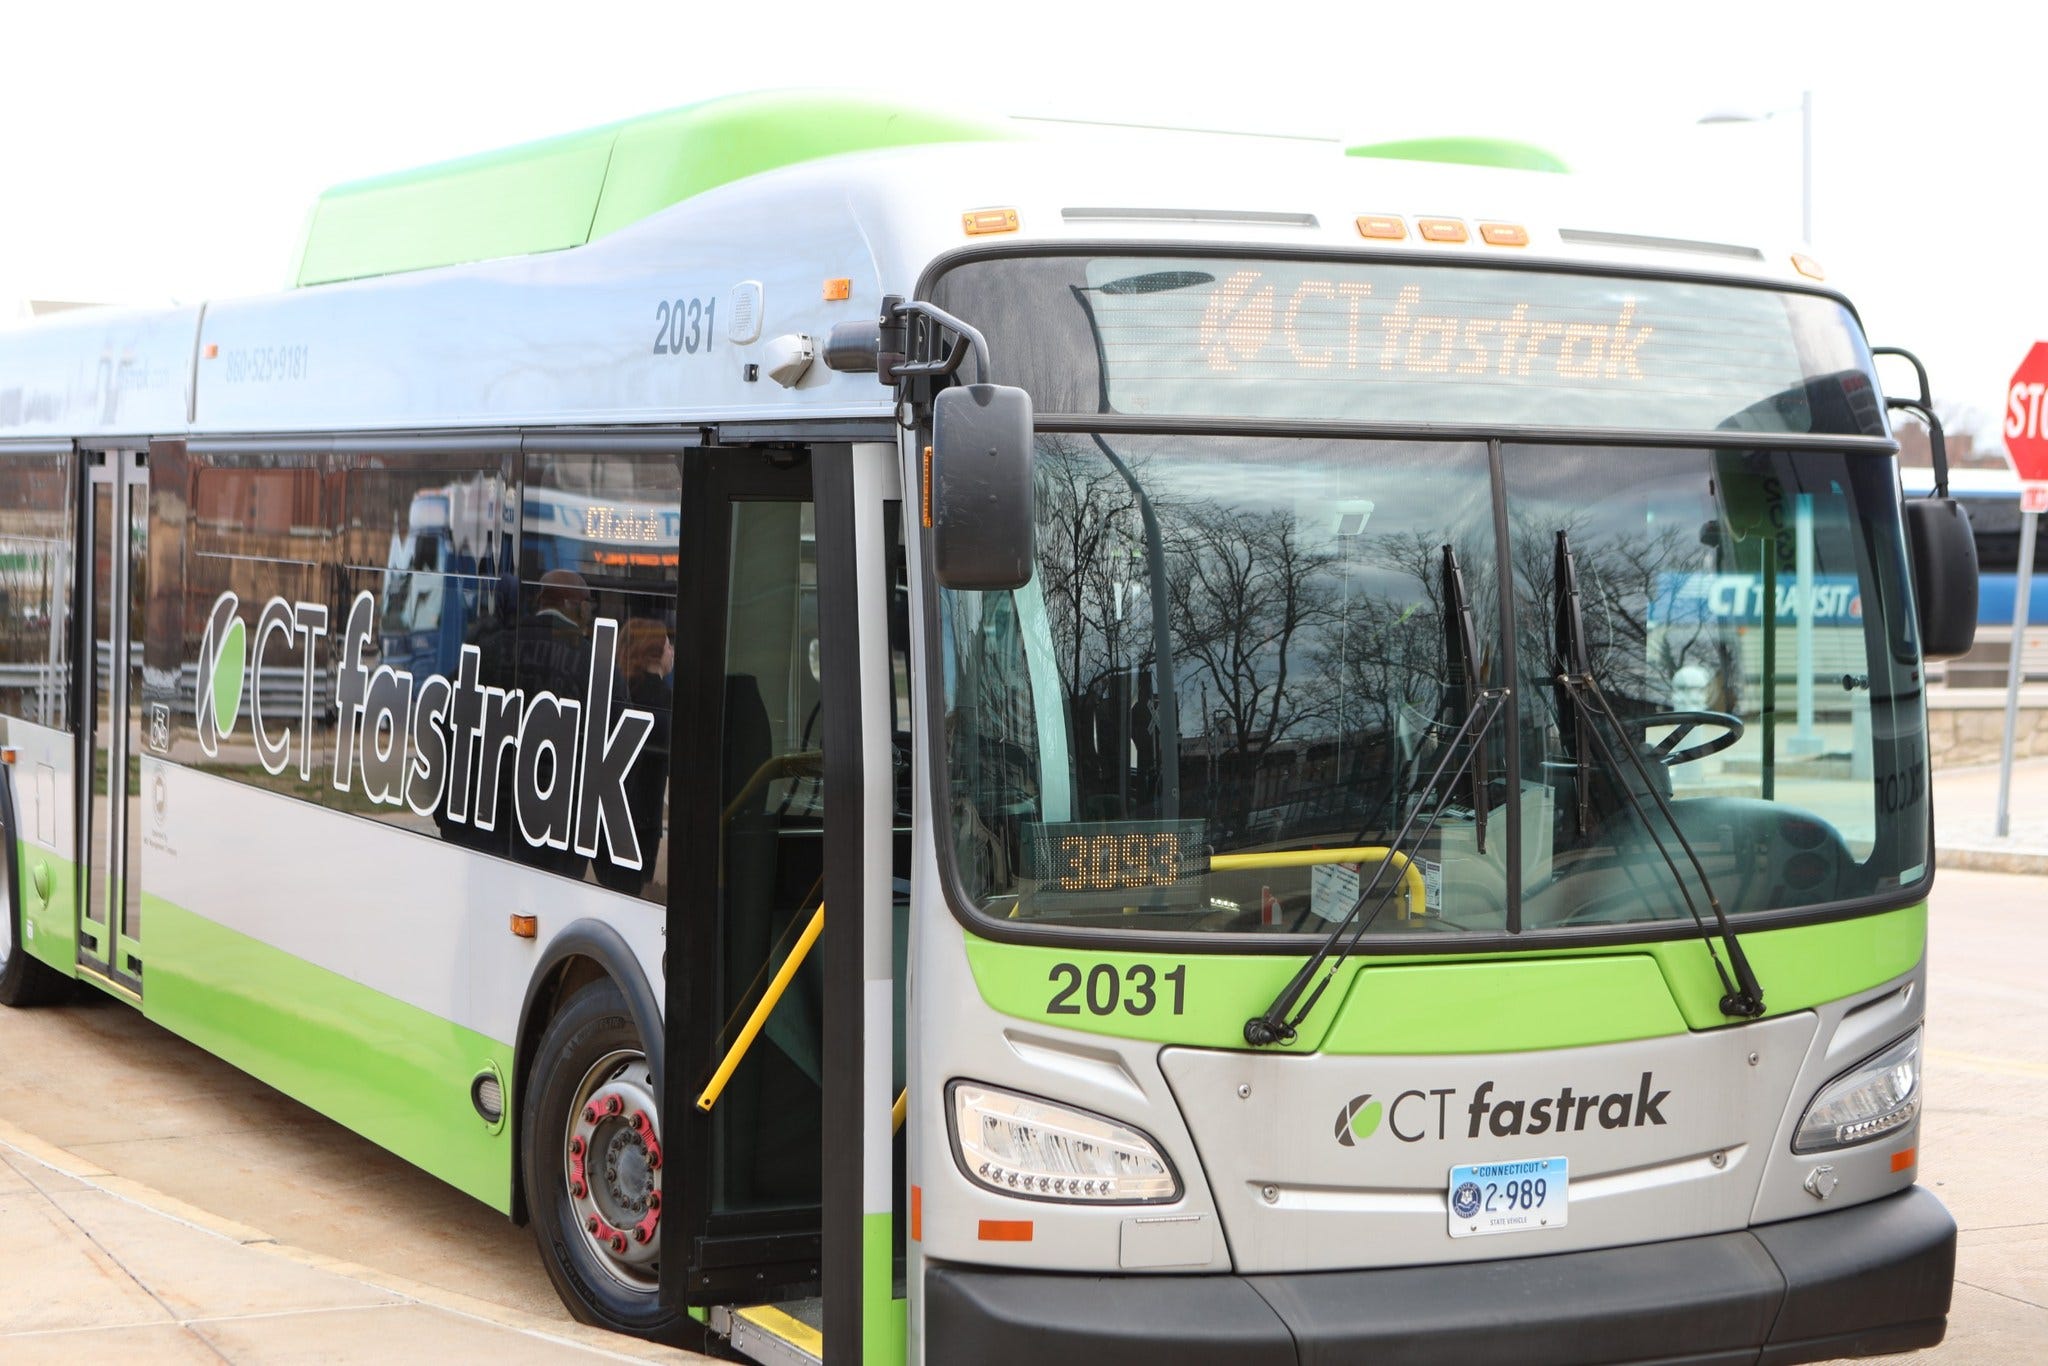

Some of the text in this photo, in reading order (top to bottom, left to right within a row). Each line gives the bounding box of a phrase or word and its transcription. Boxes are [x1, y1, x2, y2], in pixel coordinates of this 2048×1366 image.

[653, 296, 716, 355] 2031
[1284, 281, 1654, 381] CT fastrak
[250, 589, 656, 871] CT fastrak
[1059, 832, 1180, 892] 3093
[1046, 963, 1187, 1017] 2031
[1388, 1071, 1673, 1143] CT fastrak
[1479, 1162, 1540, 1178] CONNECTICUT
[1490, 1216, 1528, 1226] STATE VEHICLE
